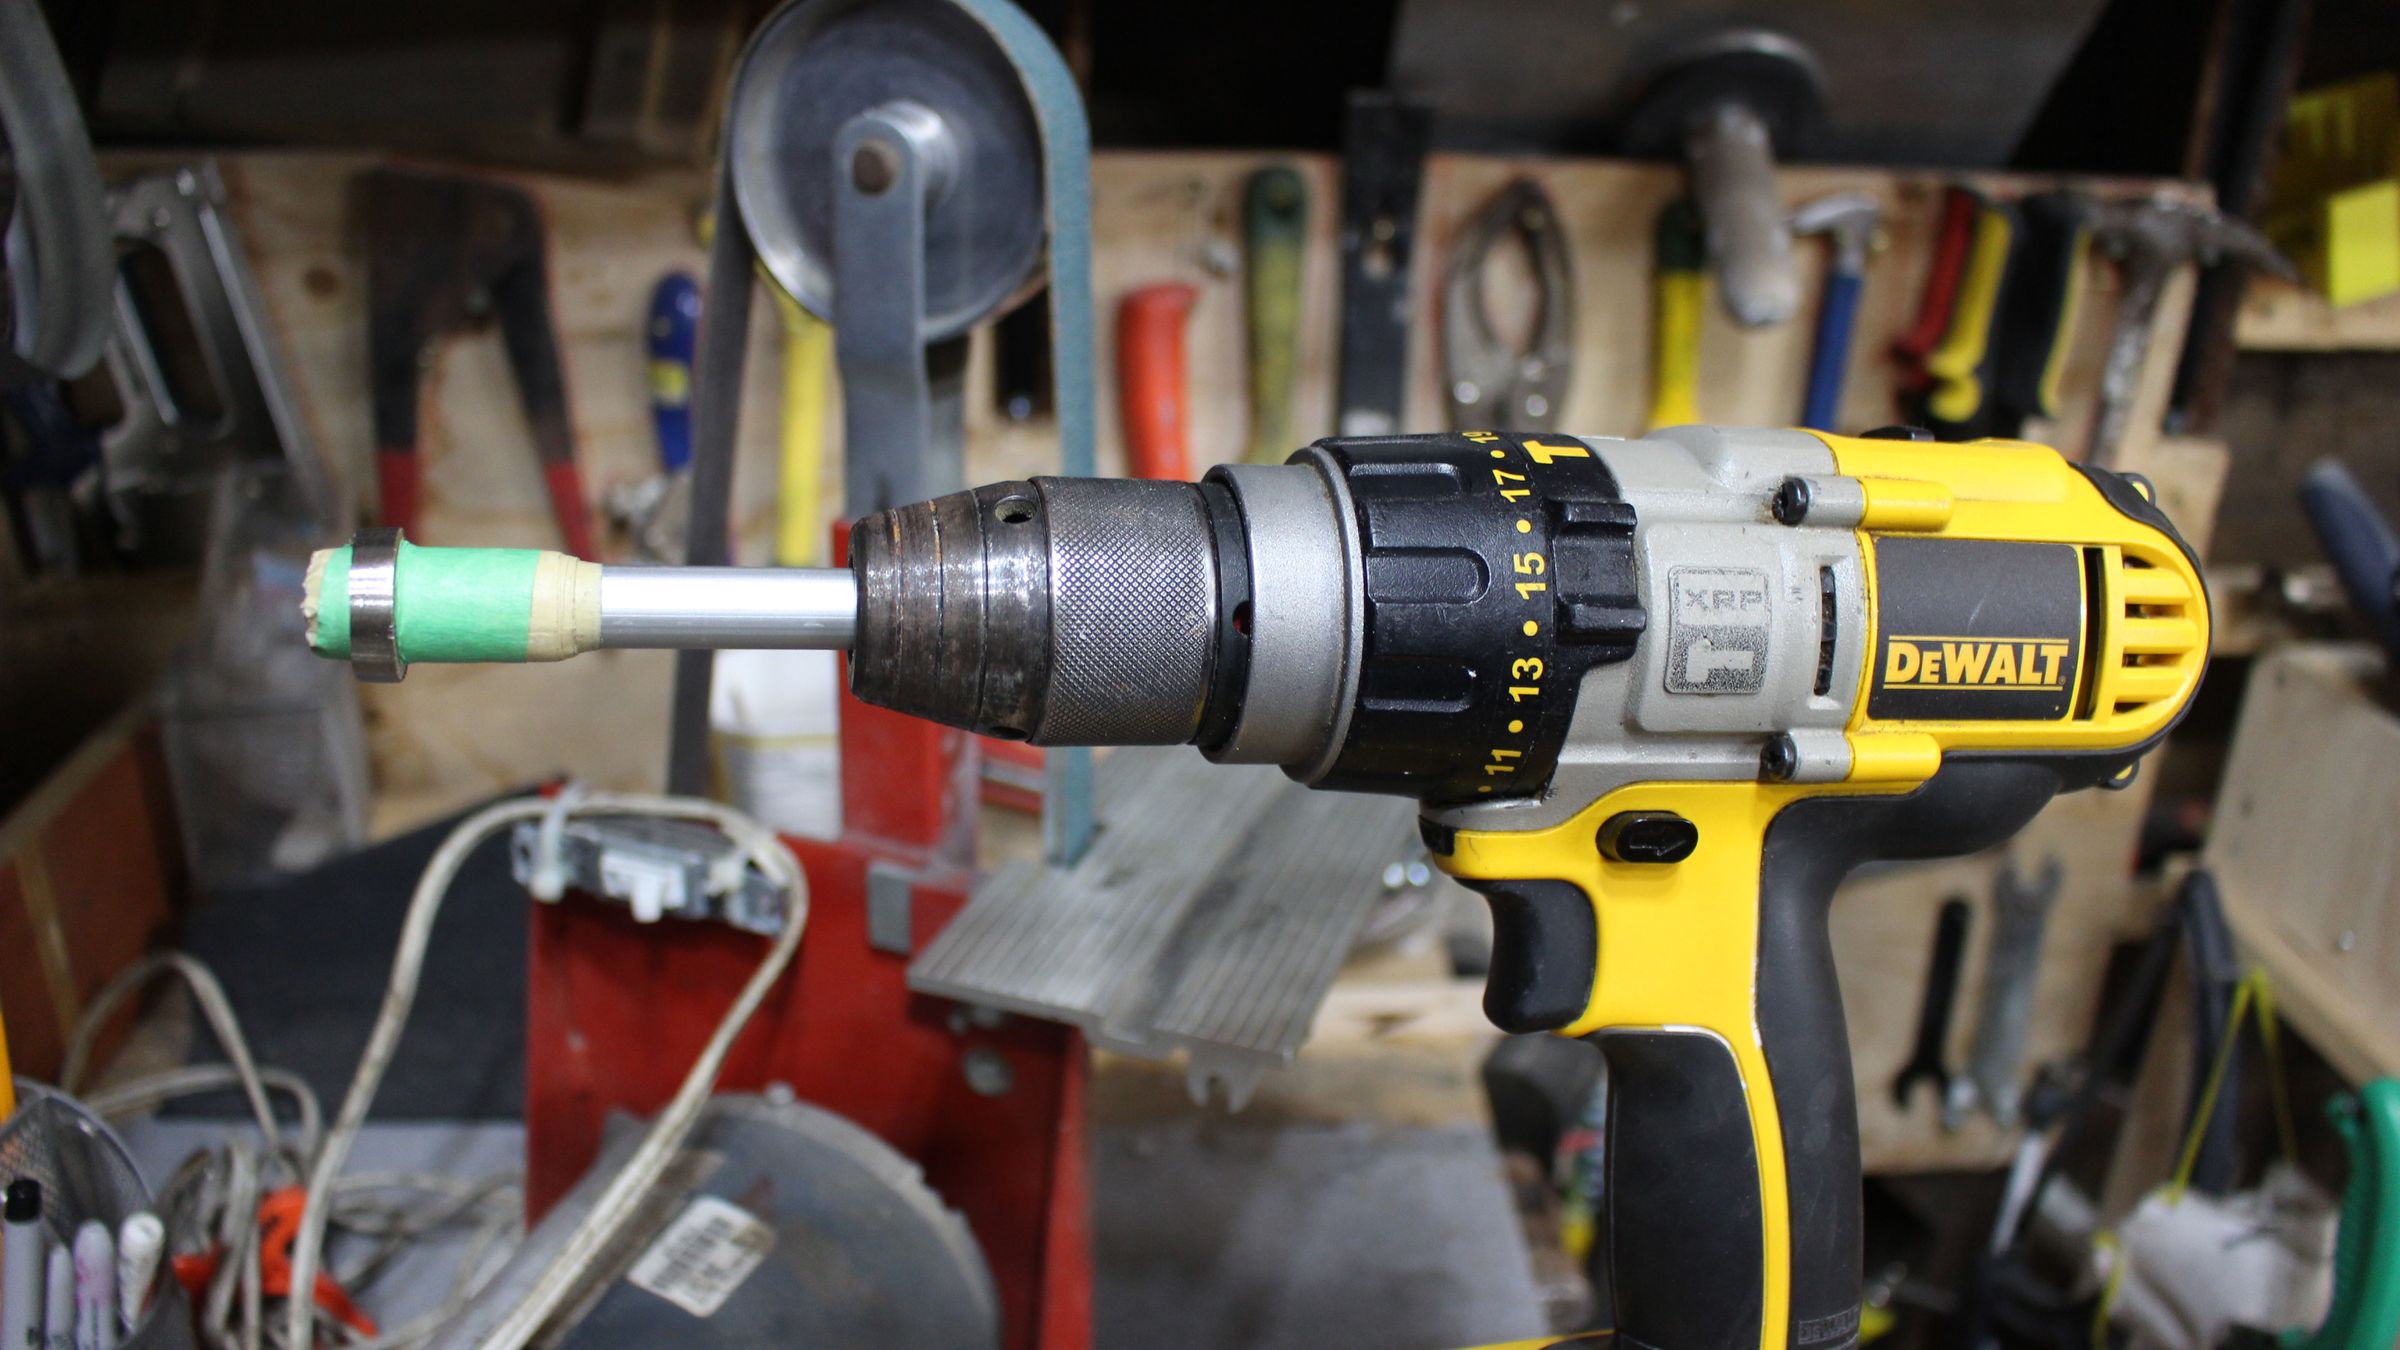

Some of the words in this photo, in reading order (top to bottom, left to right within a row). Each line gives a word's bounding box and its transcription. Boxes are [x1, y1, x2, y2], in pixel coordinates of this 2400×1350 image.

[1493, 468, 1531, 503] 17
[1514, 552, 1546, 600] 15
[1686, 589, 1762, 610] XRP
[1508, 656, 1544, 703] 13
[1485, 748, 1522, 776] 11
